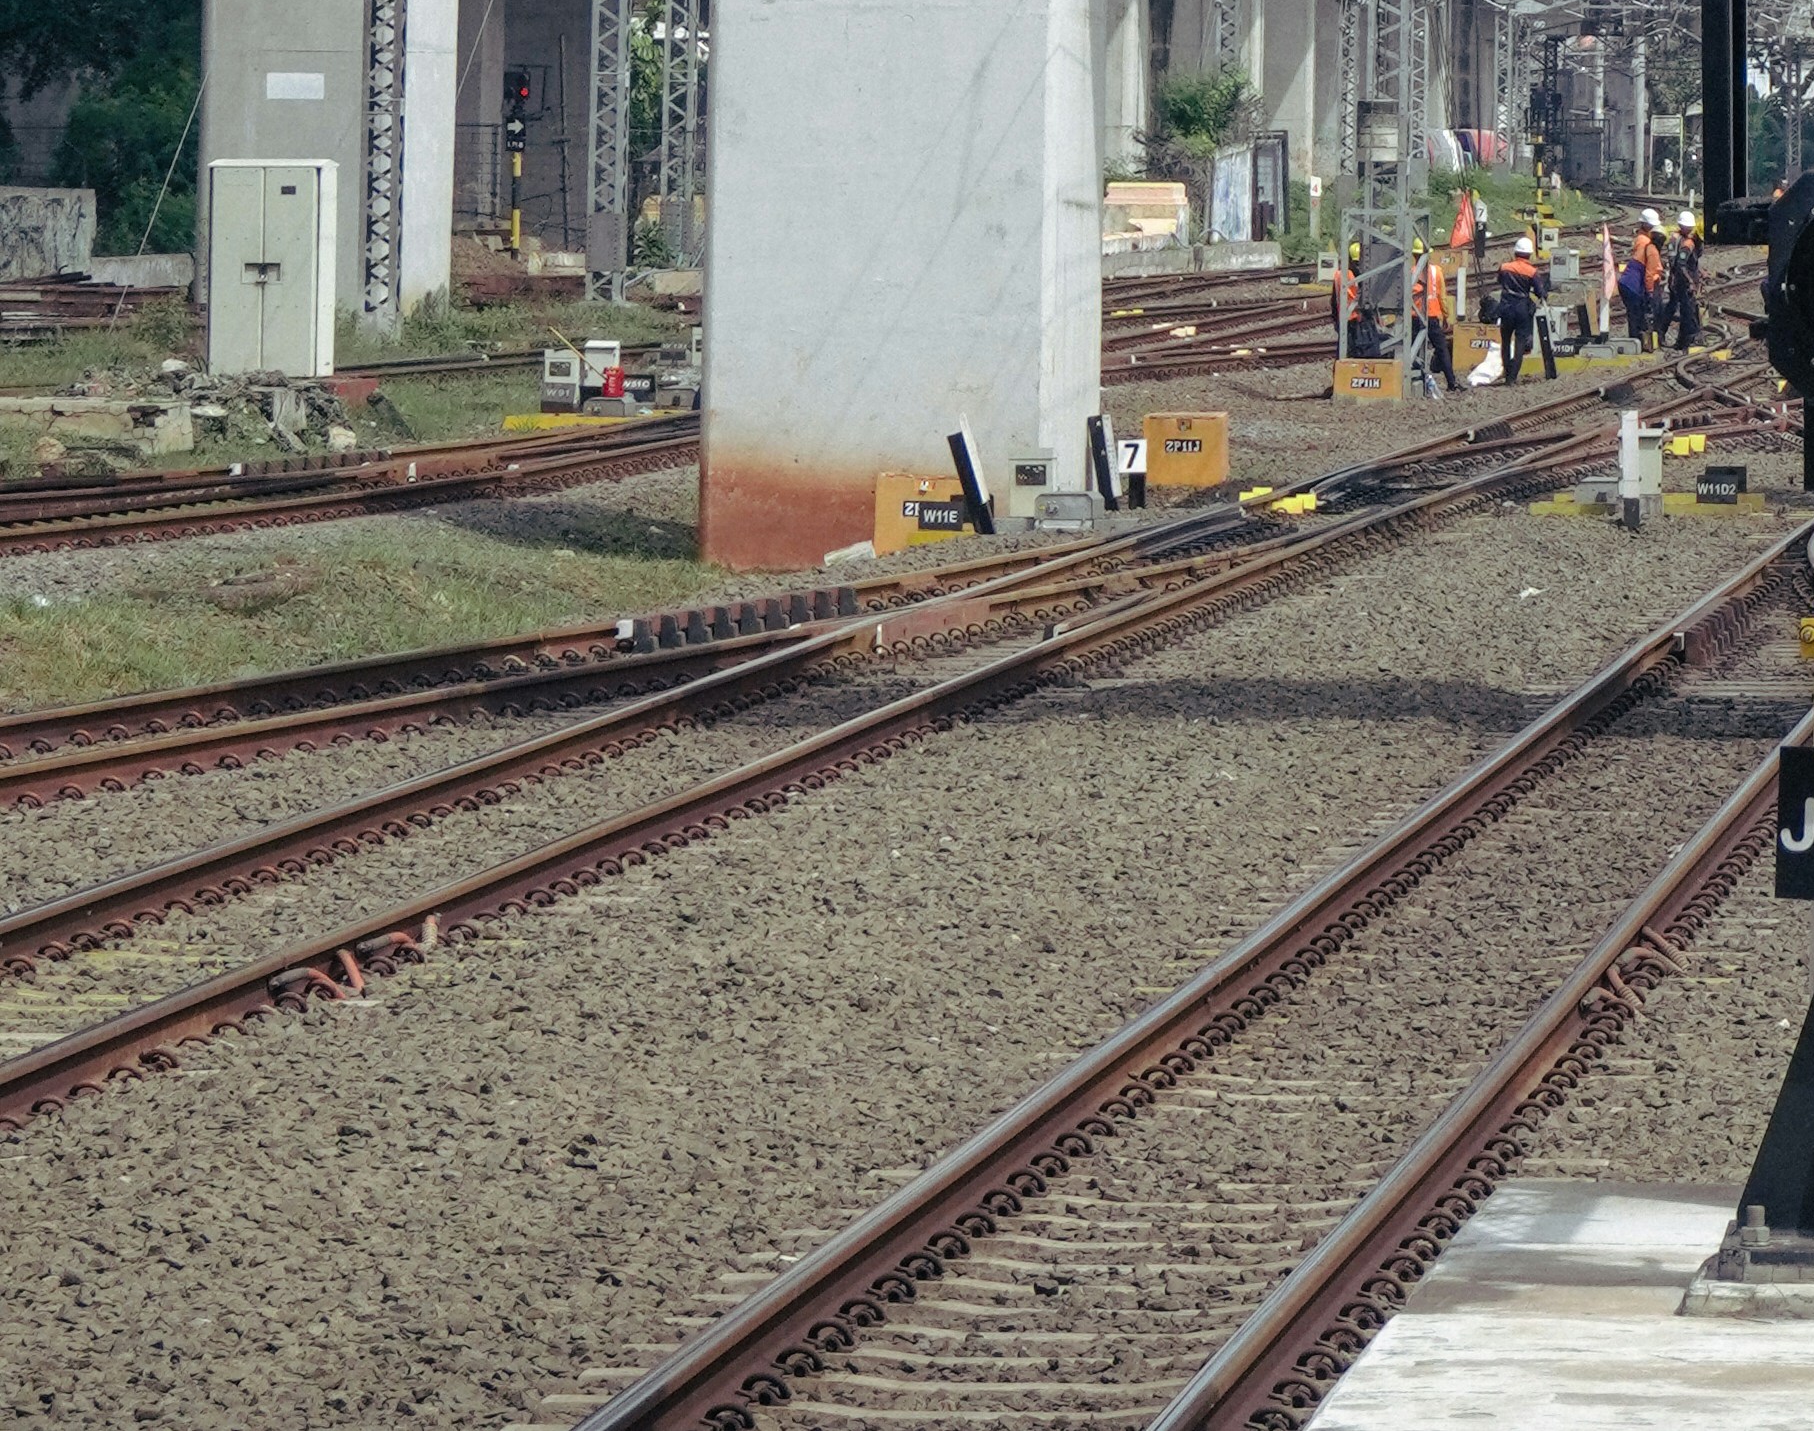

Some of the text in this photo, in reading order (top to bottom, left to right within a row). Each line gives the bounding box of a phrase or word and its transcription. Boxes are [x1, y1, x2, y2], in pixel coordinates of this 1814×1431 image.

[1478, 208, 1484, 218] 7
[1124, 443, 1140, 469] 7
[1697, 482, 1736, 495] W11D2
[923, 508, 959, 523] W11E
